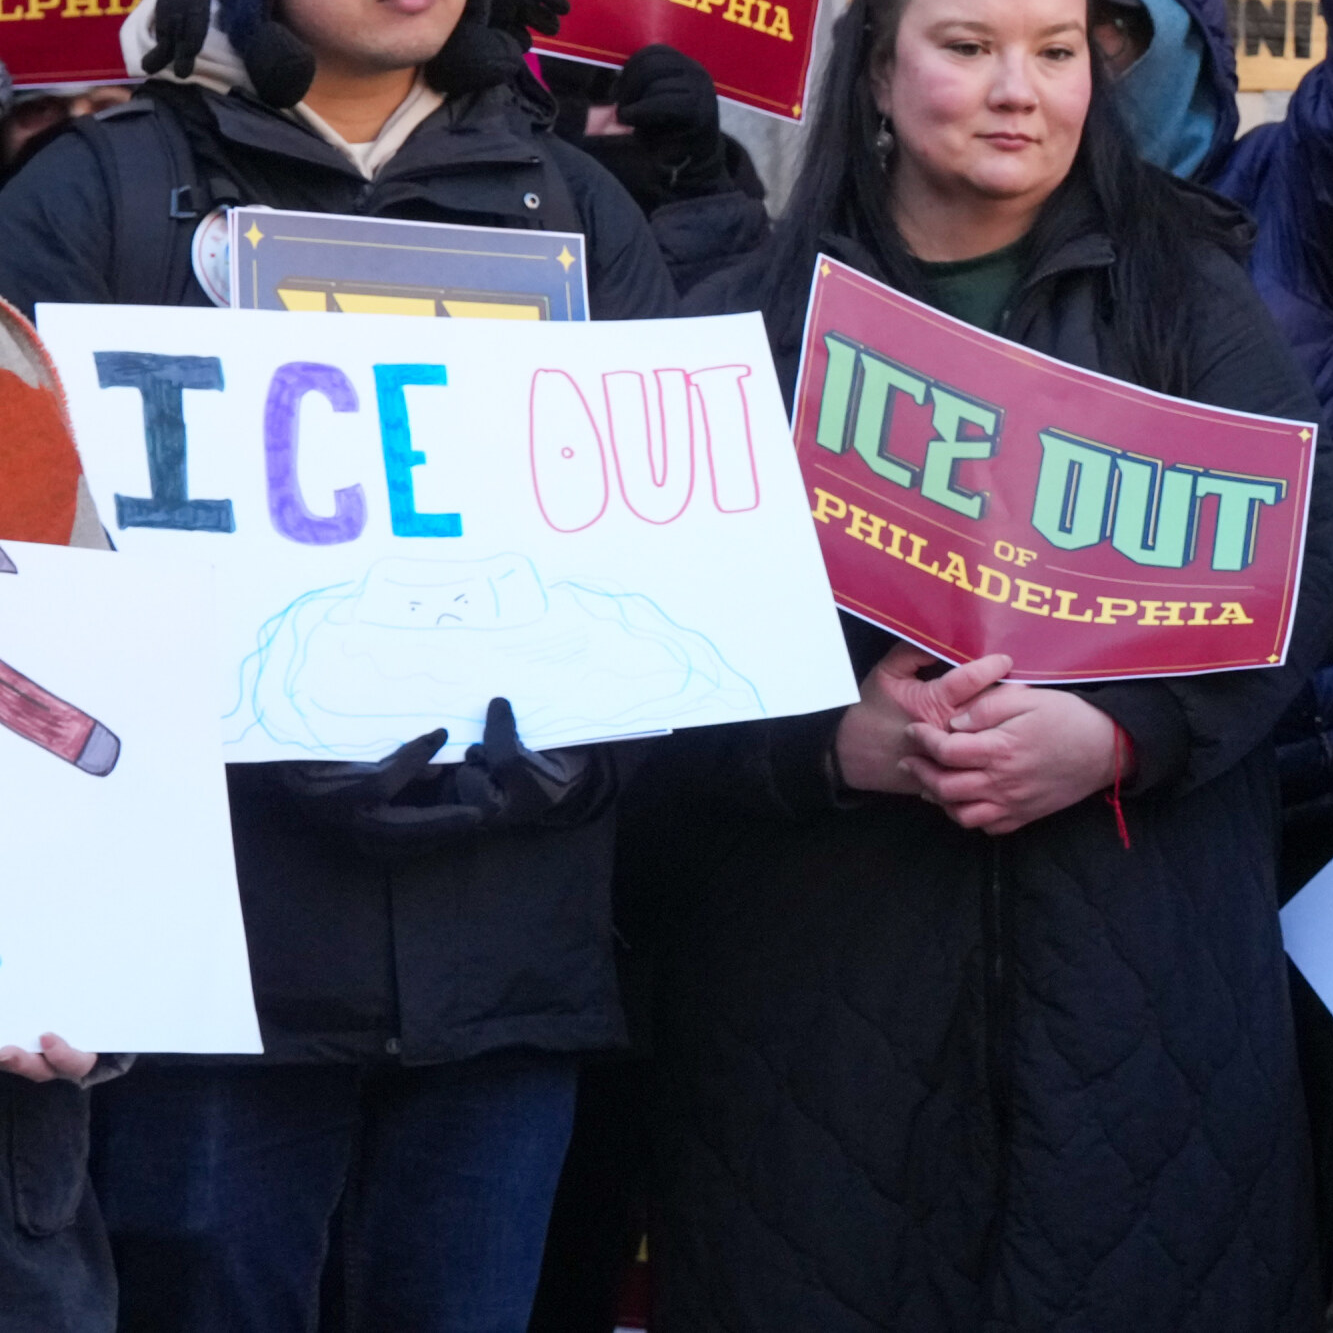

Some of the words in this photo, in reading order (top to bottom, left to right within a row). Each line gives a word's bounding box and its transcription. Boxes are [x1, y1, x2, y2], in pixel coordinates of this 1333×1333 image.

[93, 351, 463, 545] ICE
[529, 364, 761, 533] OUT
[816, 329, 1006, 521] ICE
[1030, 426, 1288, 572] OUT
[812, 486, 1255, 626] PHILADELPHIA
[992, 539, 1038, 568] OF
